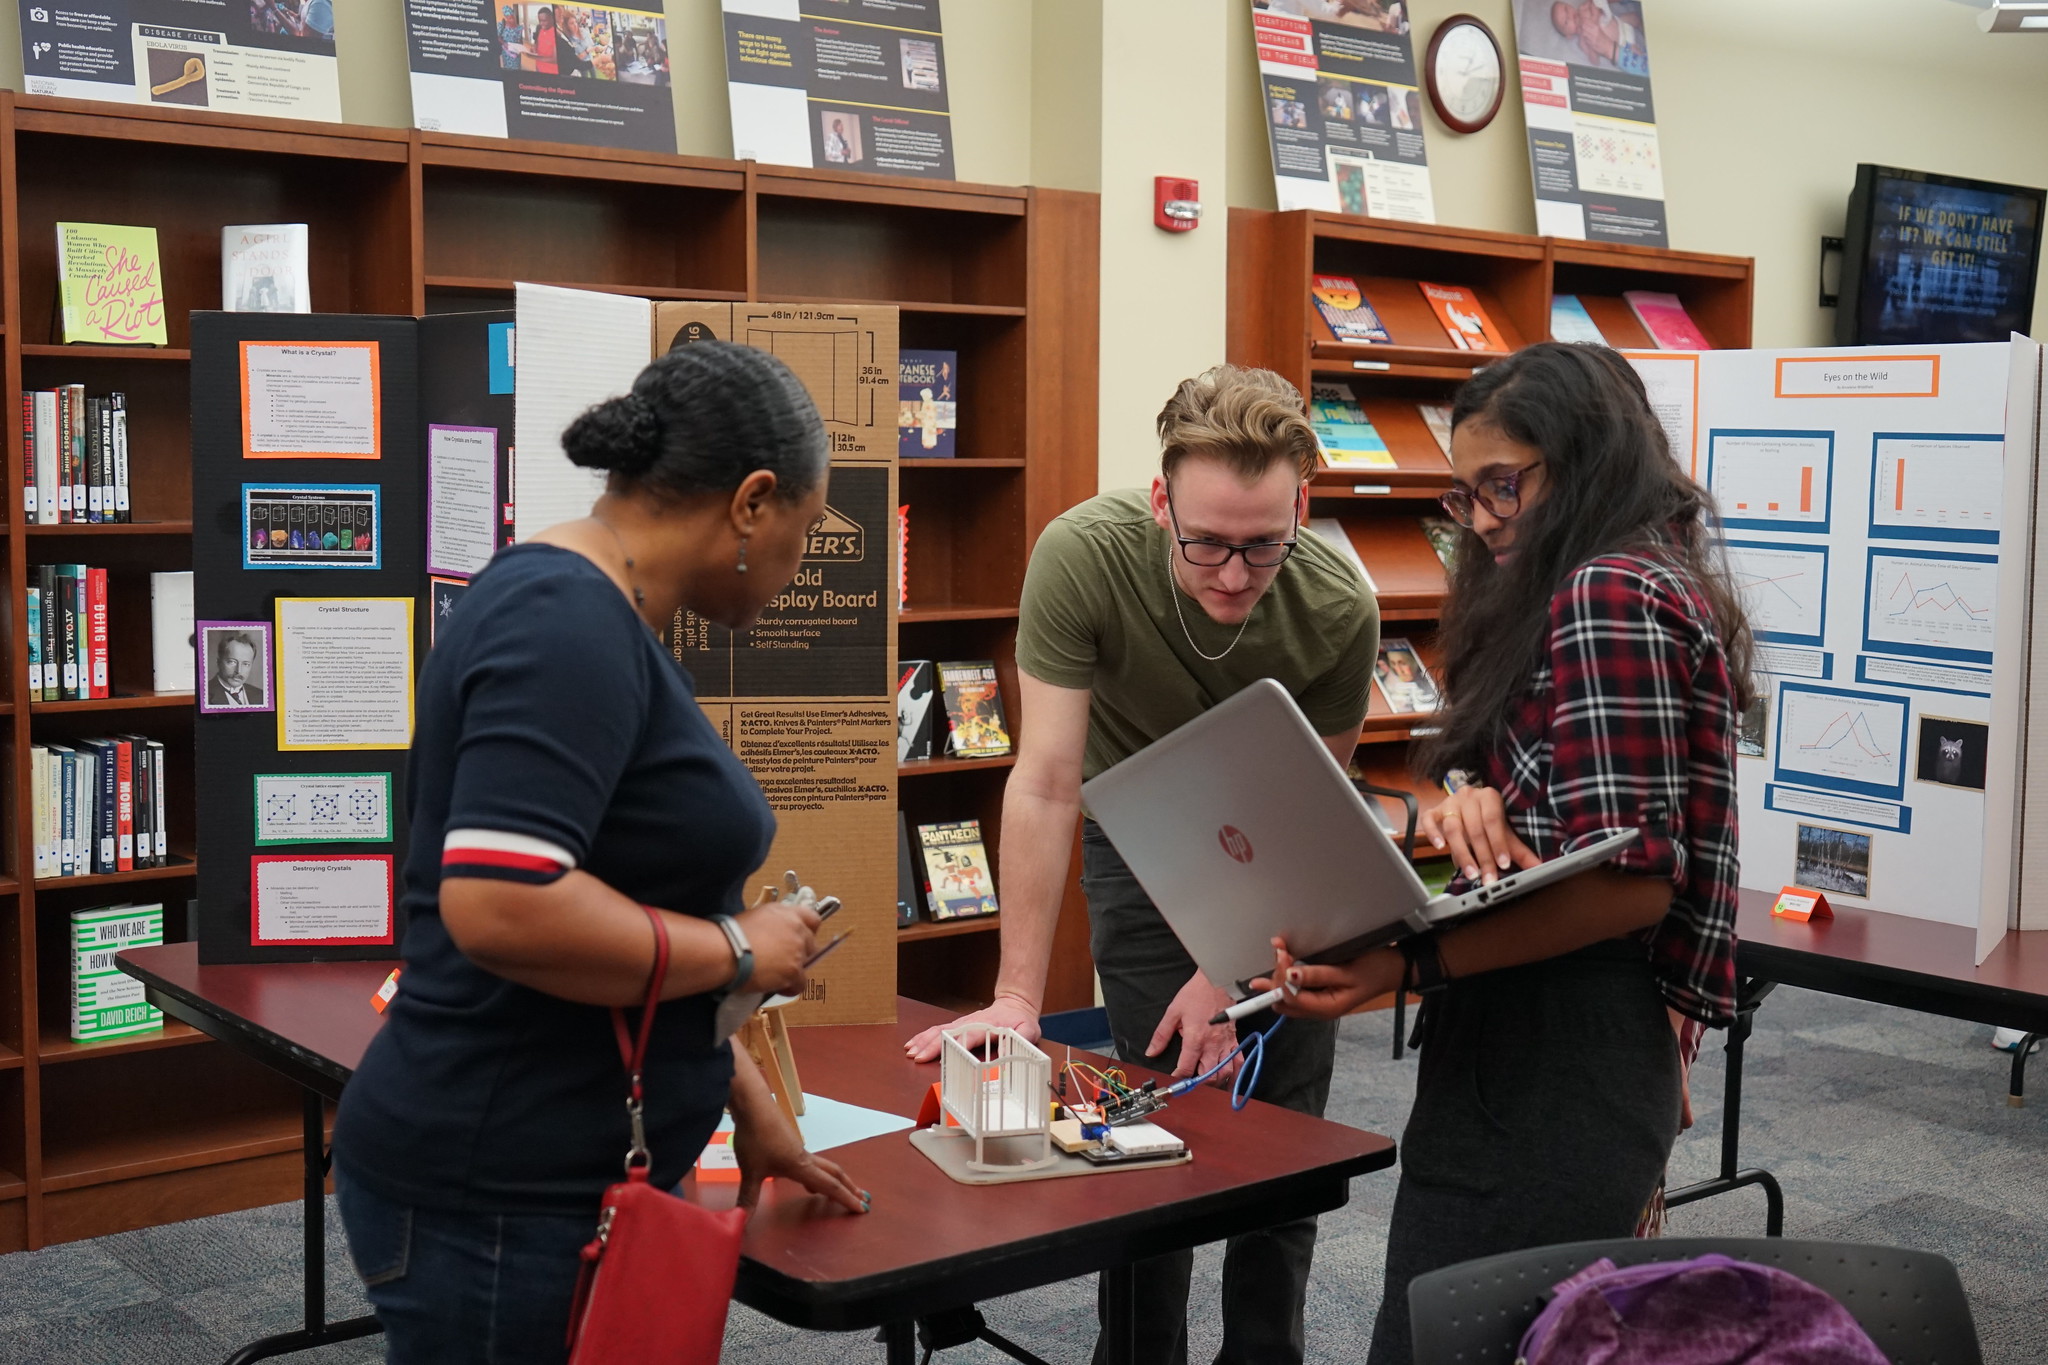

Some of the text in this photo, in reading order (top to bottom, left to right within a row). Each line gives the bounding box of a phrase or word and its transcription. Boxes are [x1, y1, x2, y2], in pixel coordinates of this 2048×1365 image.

[144, 28, 214, 42] DISEASE FILES
[740, 55, 767, 64] infectious
[756, 49, 770, 57] fight
[1899, 205, 2012, 234] IF WE DON'T HAVE
[240, 234, 289, 244] A GIRL
[1900, 226, 2008, 252] IT? WE CAN STILL
[232, 250, 288, 261] STANDS
[1932, 251, 1975, 269] GET IT!
[106, 246, 142, 282] She
[250, 266, 292, 276] DOOR
[86, 262, 156, 306] Caused
[86, 310, 102, 326] a
[100, 292, 164, 340] Riot
[899, 364, 936, 376] PANESE
[1824, 373, 1840, 382] Eyes
[1870, 372, 1888, 380] Wild
[859, 376, 876, 386] 91.4
[24, 396, 34, 432] FASCISM
[102, 428, 110, 445] PACK
[838, 443, 853, 452] 30.5
[103, 446, 112, 476] AMERICA
[802, 536, 856, 554] ER'S
[794, 568, 822, 586] old
[766, 590, 877, 610] splay Board
[44, 591, 56, 664] Significant Figure
[66, 608, 74, 641] ATOM
[685, 610, 697, 647] ois plis
[756, 618, 784, 626] Sturdy
[784, 618, 831, 626] corrugated
[94, 604, 106, 664] DOING HA
[756, 629, 821, 637] Smooth surface
[772, 640, 810, 650] Standing
[982, 668, 996, 680] 451
[848, 710, 888, 718] Adhesives,
[750, 728, 784, 736] Complete
[804, 728, 832, 736] Project.
[792, 757, 824, 765] peinture
[816, 776, 856, 784] resultados!
[64, 765, 72, 816] overcoming opioid
[807, 794, 834, 802] pintura
[120, 782, 130, 822] MOMS
[789, 802, 824, 811] proyecto.
[922, 827, 980, 843] PANTHEON
[100, 920, 146, 940] WHO WE ARE
[90, 953, 108, 970] HOW
[100, 1005, 147, 1027] DAVID REICH
